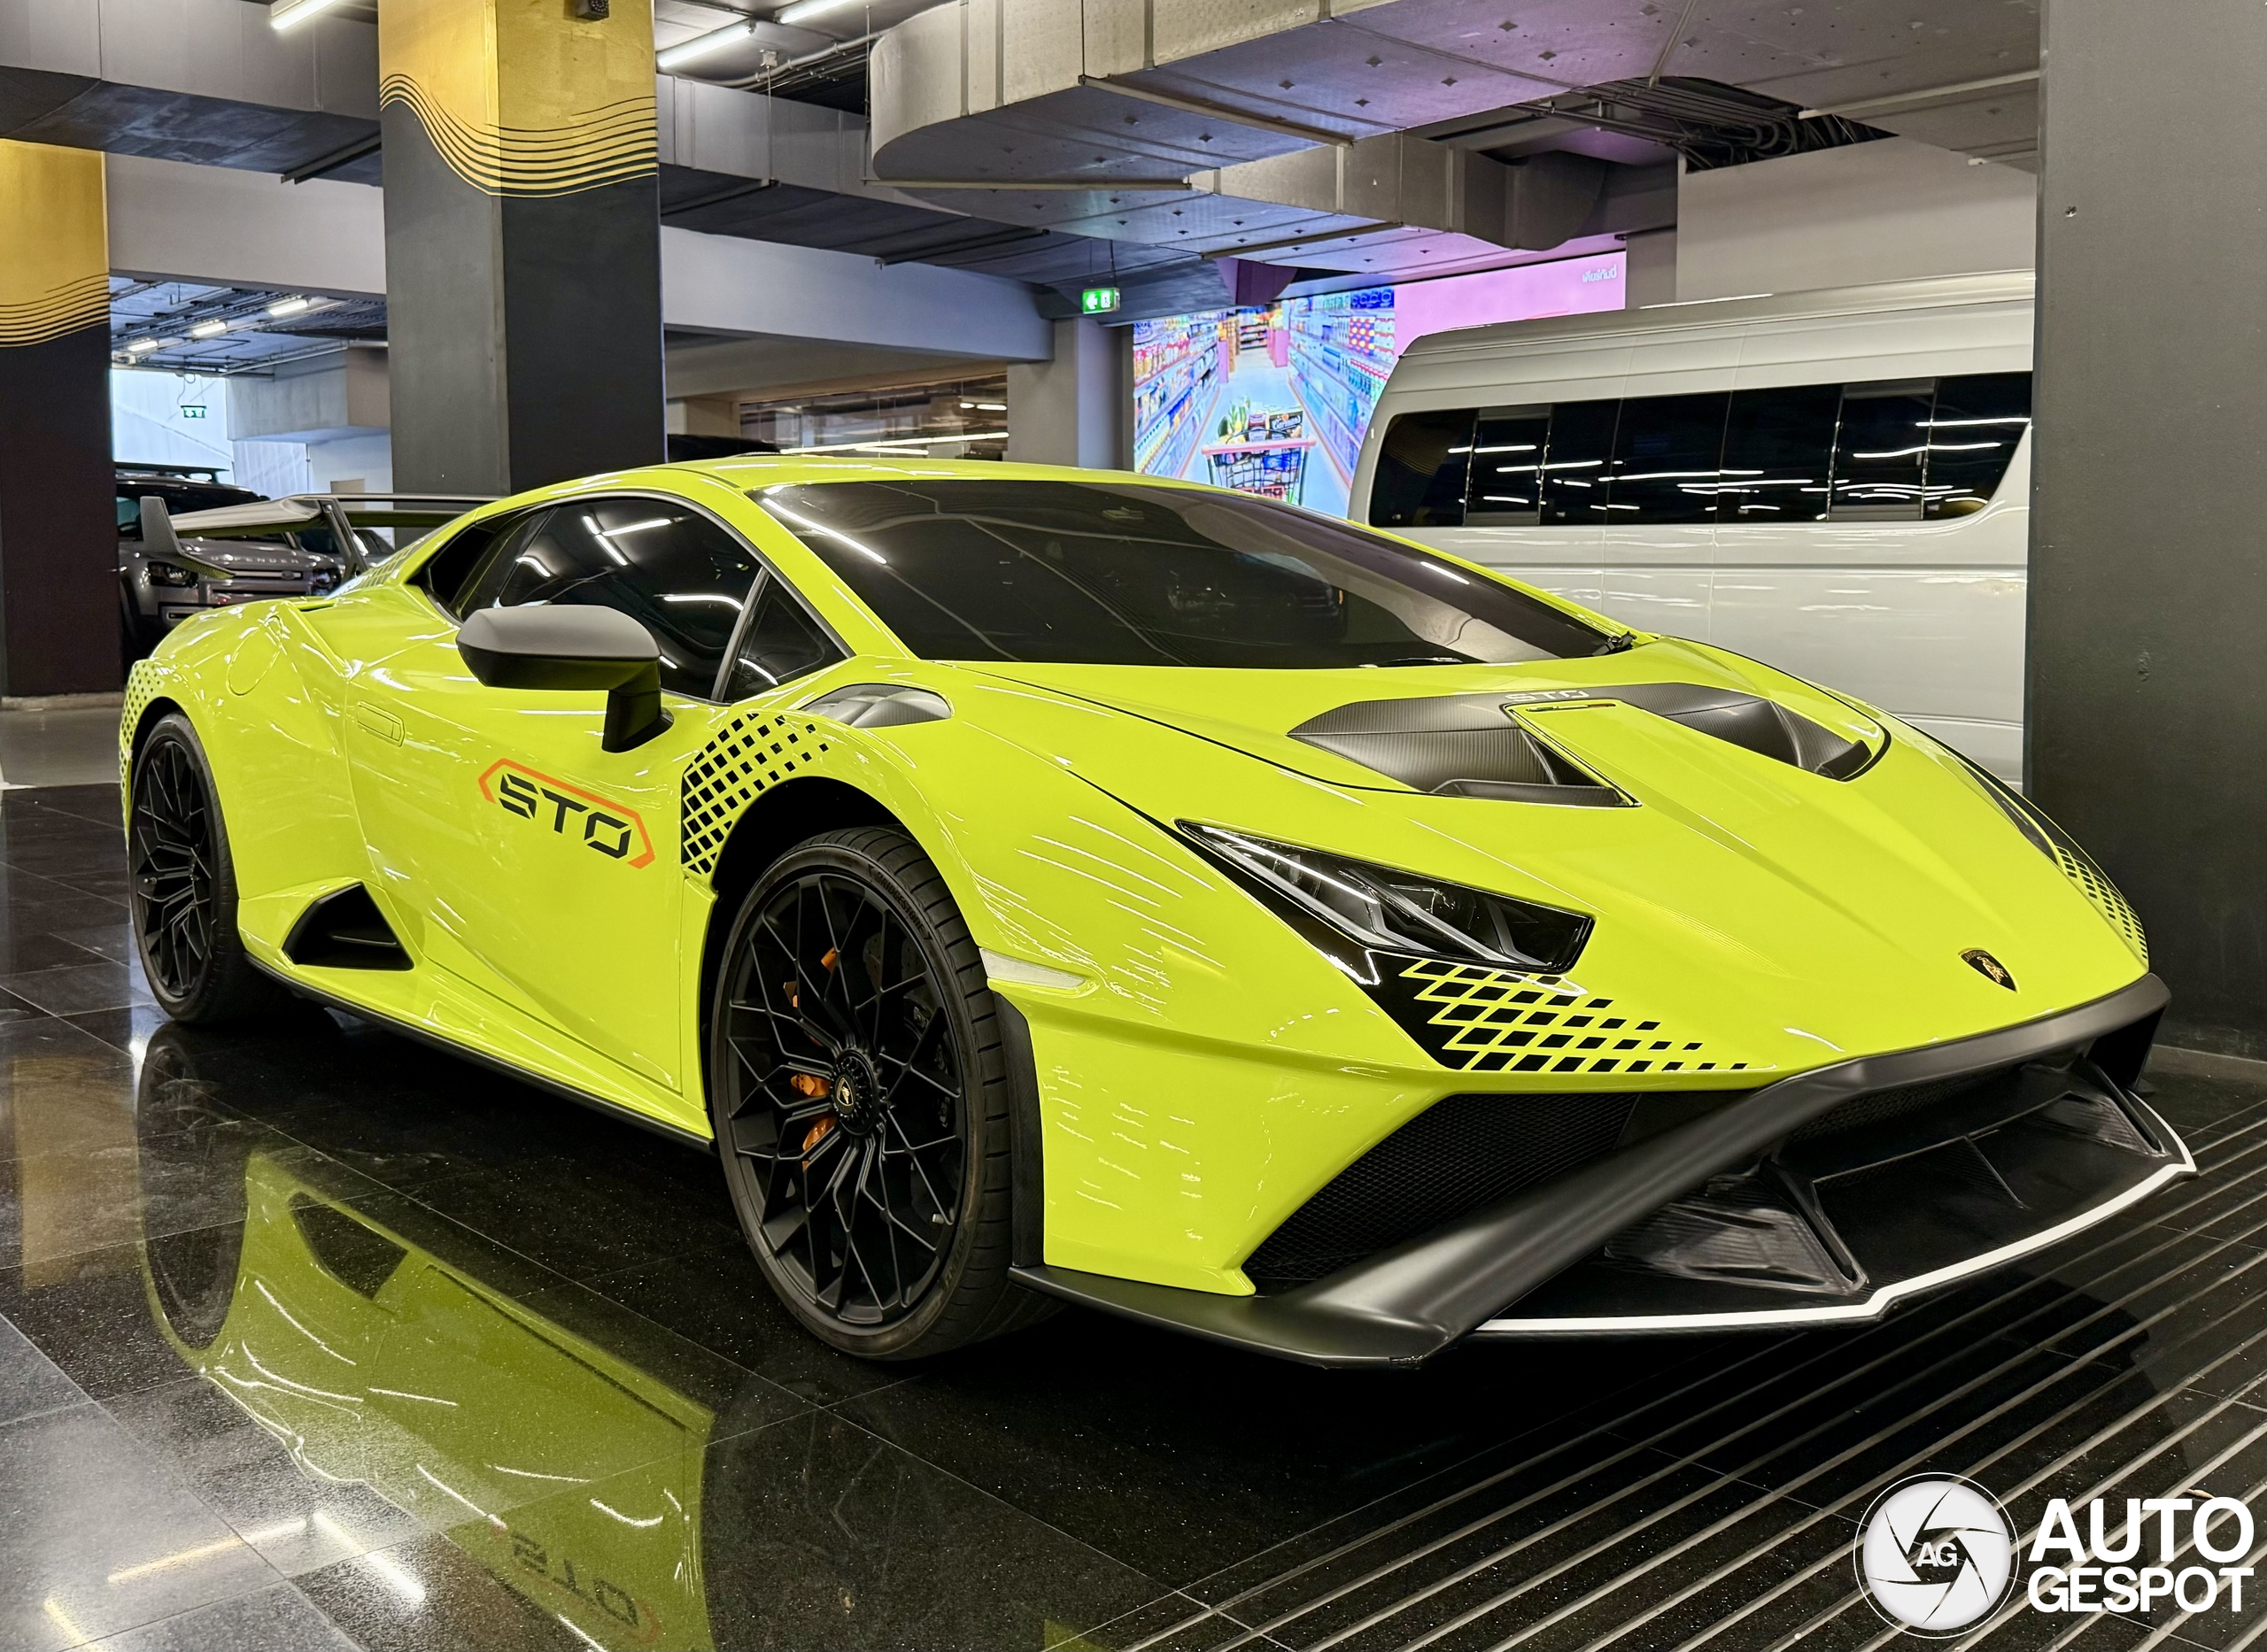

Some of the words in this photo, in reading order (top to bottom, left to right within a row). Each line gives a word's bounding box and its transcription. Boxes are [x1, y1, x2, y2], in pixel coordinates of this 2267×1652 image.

[1505, 690, 1590, 703] STO
[499, 773, 631, 860] STO
[873, 870, 925, 932] BRIDGESTONE
